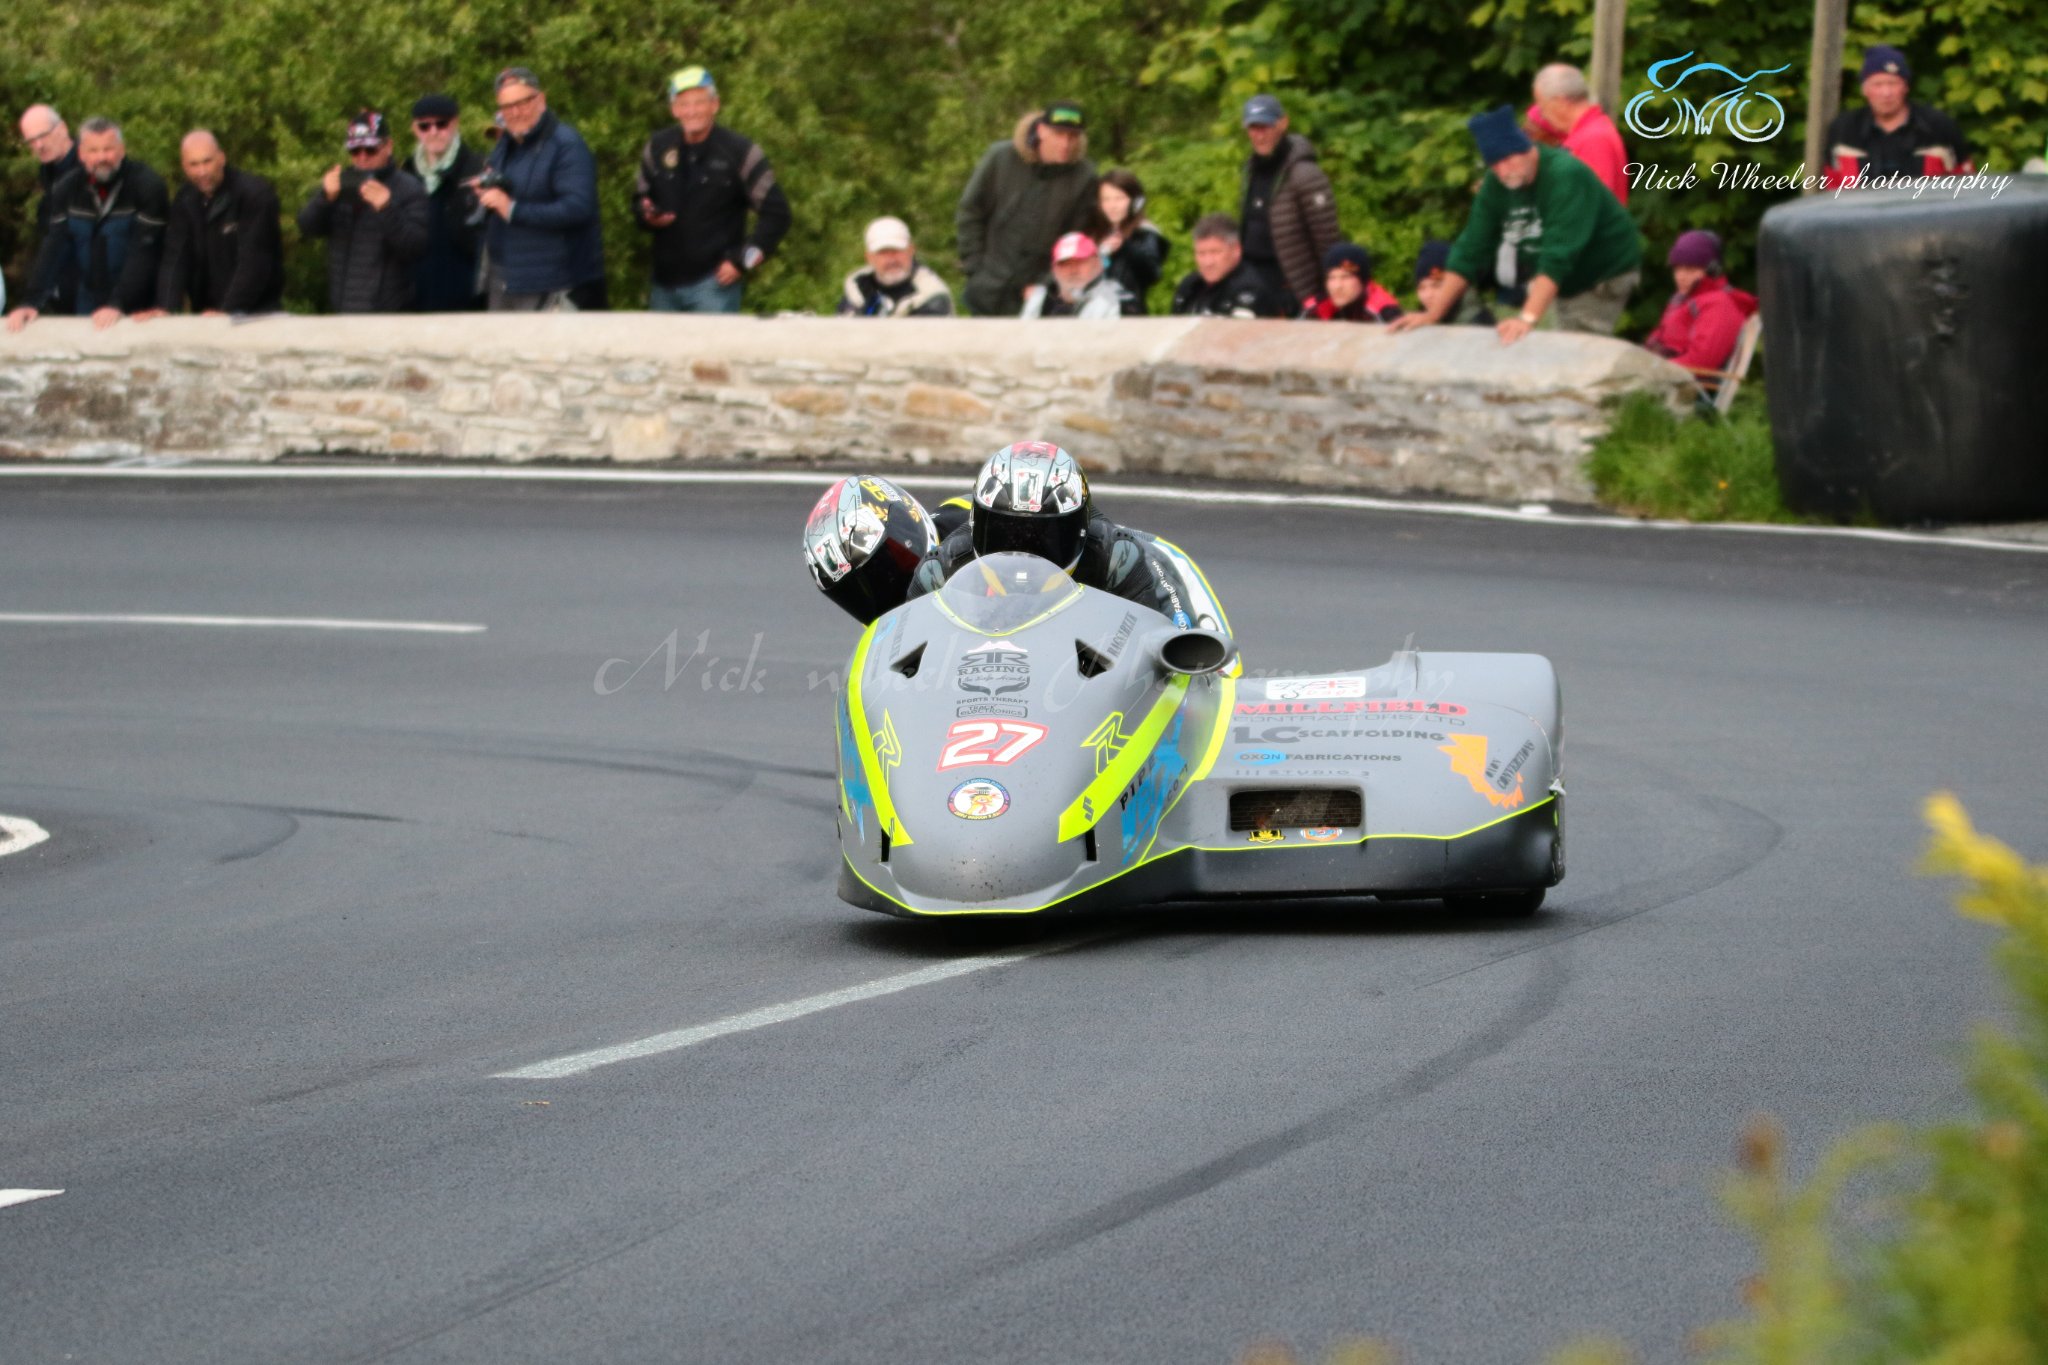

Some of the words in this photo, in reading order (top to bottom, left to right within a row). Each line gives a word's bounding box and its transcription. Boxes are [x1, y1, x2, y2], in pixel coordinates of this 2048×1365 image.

[957, 664, 1030, 676] RACING
[956, 697, 989, 705] SPORTS
[991, 697, 1029, 705] THERAPY
[1234, 700, 1468, 717] MILLFIELD
[1425, 715, 1466, 726] LTD
[1233, 726, 1302, 744] LC
[1298, 729, 1446, 742] SCAFFOLDING
[937, 719, 1049, 771] 27
[1239, 753, 1281, 761] OXON
[1284, 753, 1403, 762] FABRICATIONS
